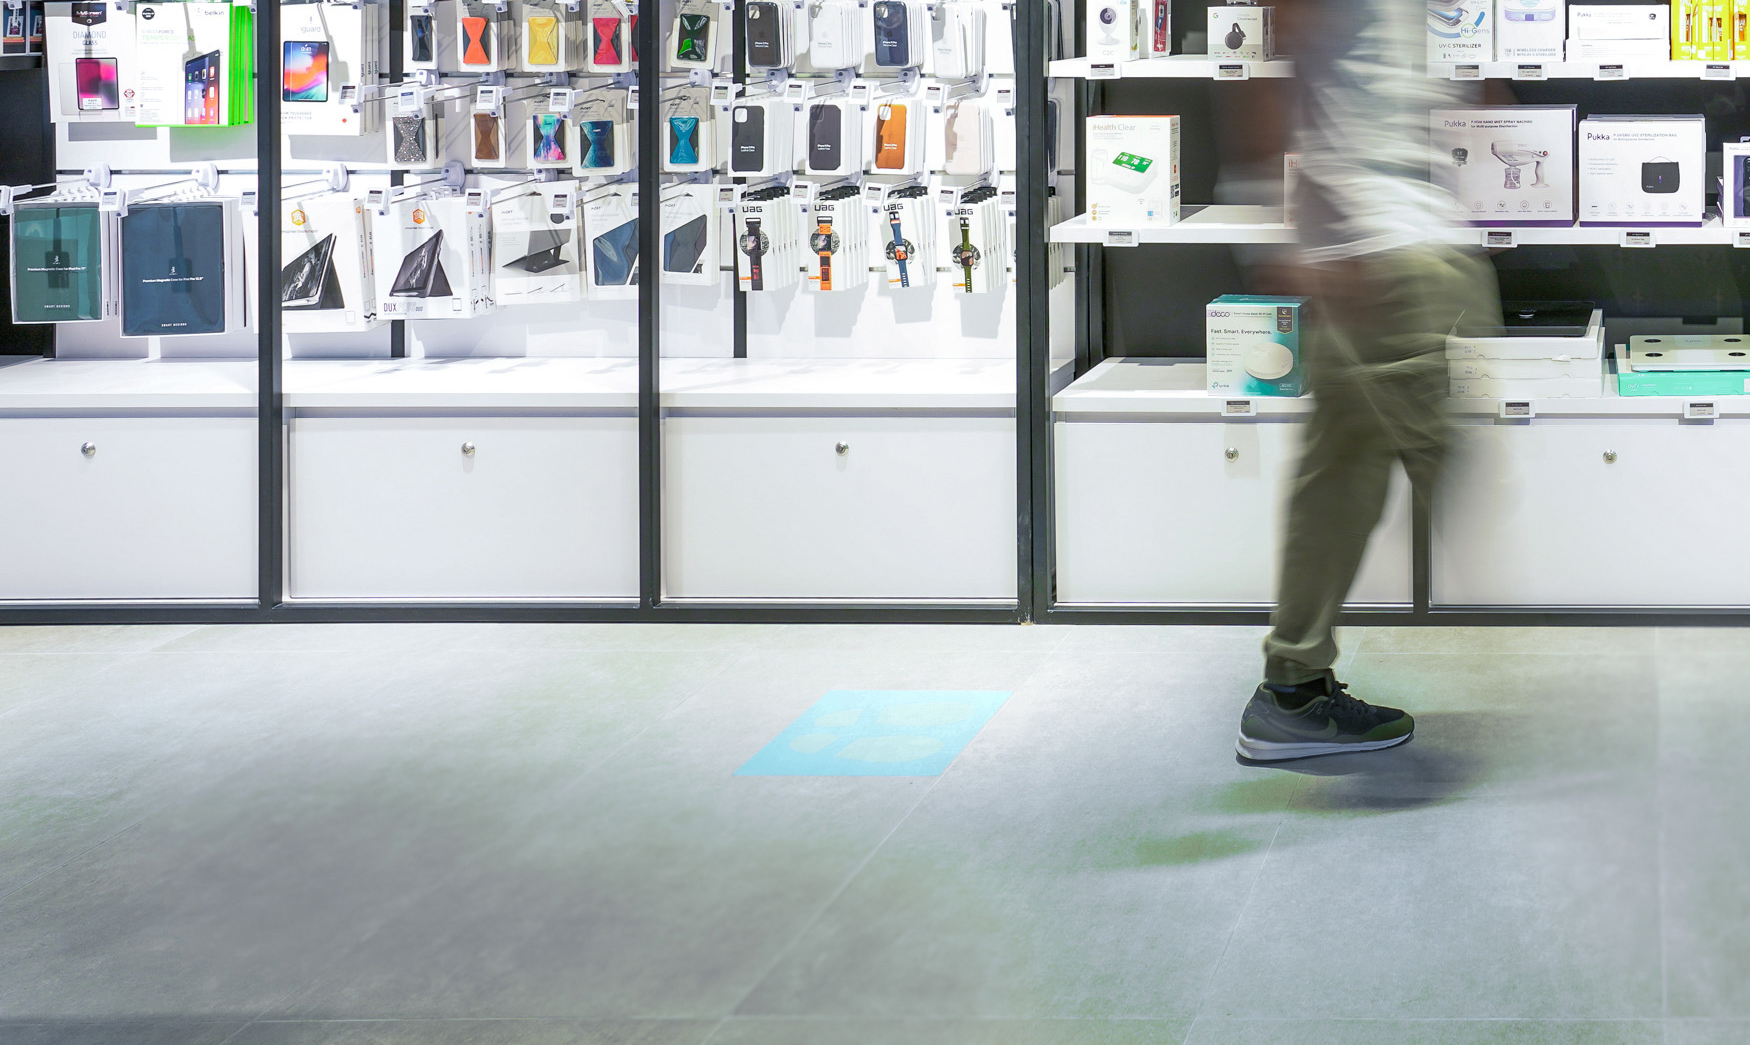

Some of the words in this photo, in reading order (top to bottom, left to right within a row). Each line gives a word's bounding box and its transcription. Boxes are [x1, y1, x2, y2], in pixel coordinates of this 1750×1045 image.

[73, 31, 107, 39] DIAMOND
[1444, 120, 1466, 128] Pukka
[1587, 132, 1610, 141] Pukka
[742, 205, 763, 213] UAG
[814, 204, 835, 212] UAG
[883, 203, 904, 212] UAG
[383, 303, 397, 312] DUX
[1211, 310, 1231, 318] deco
